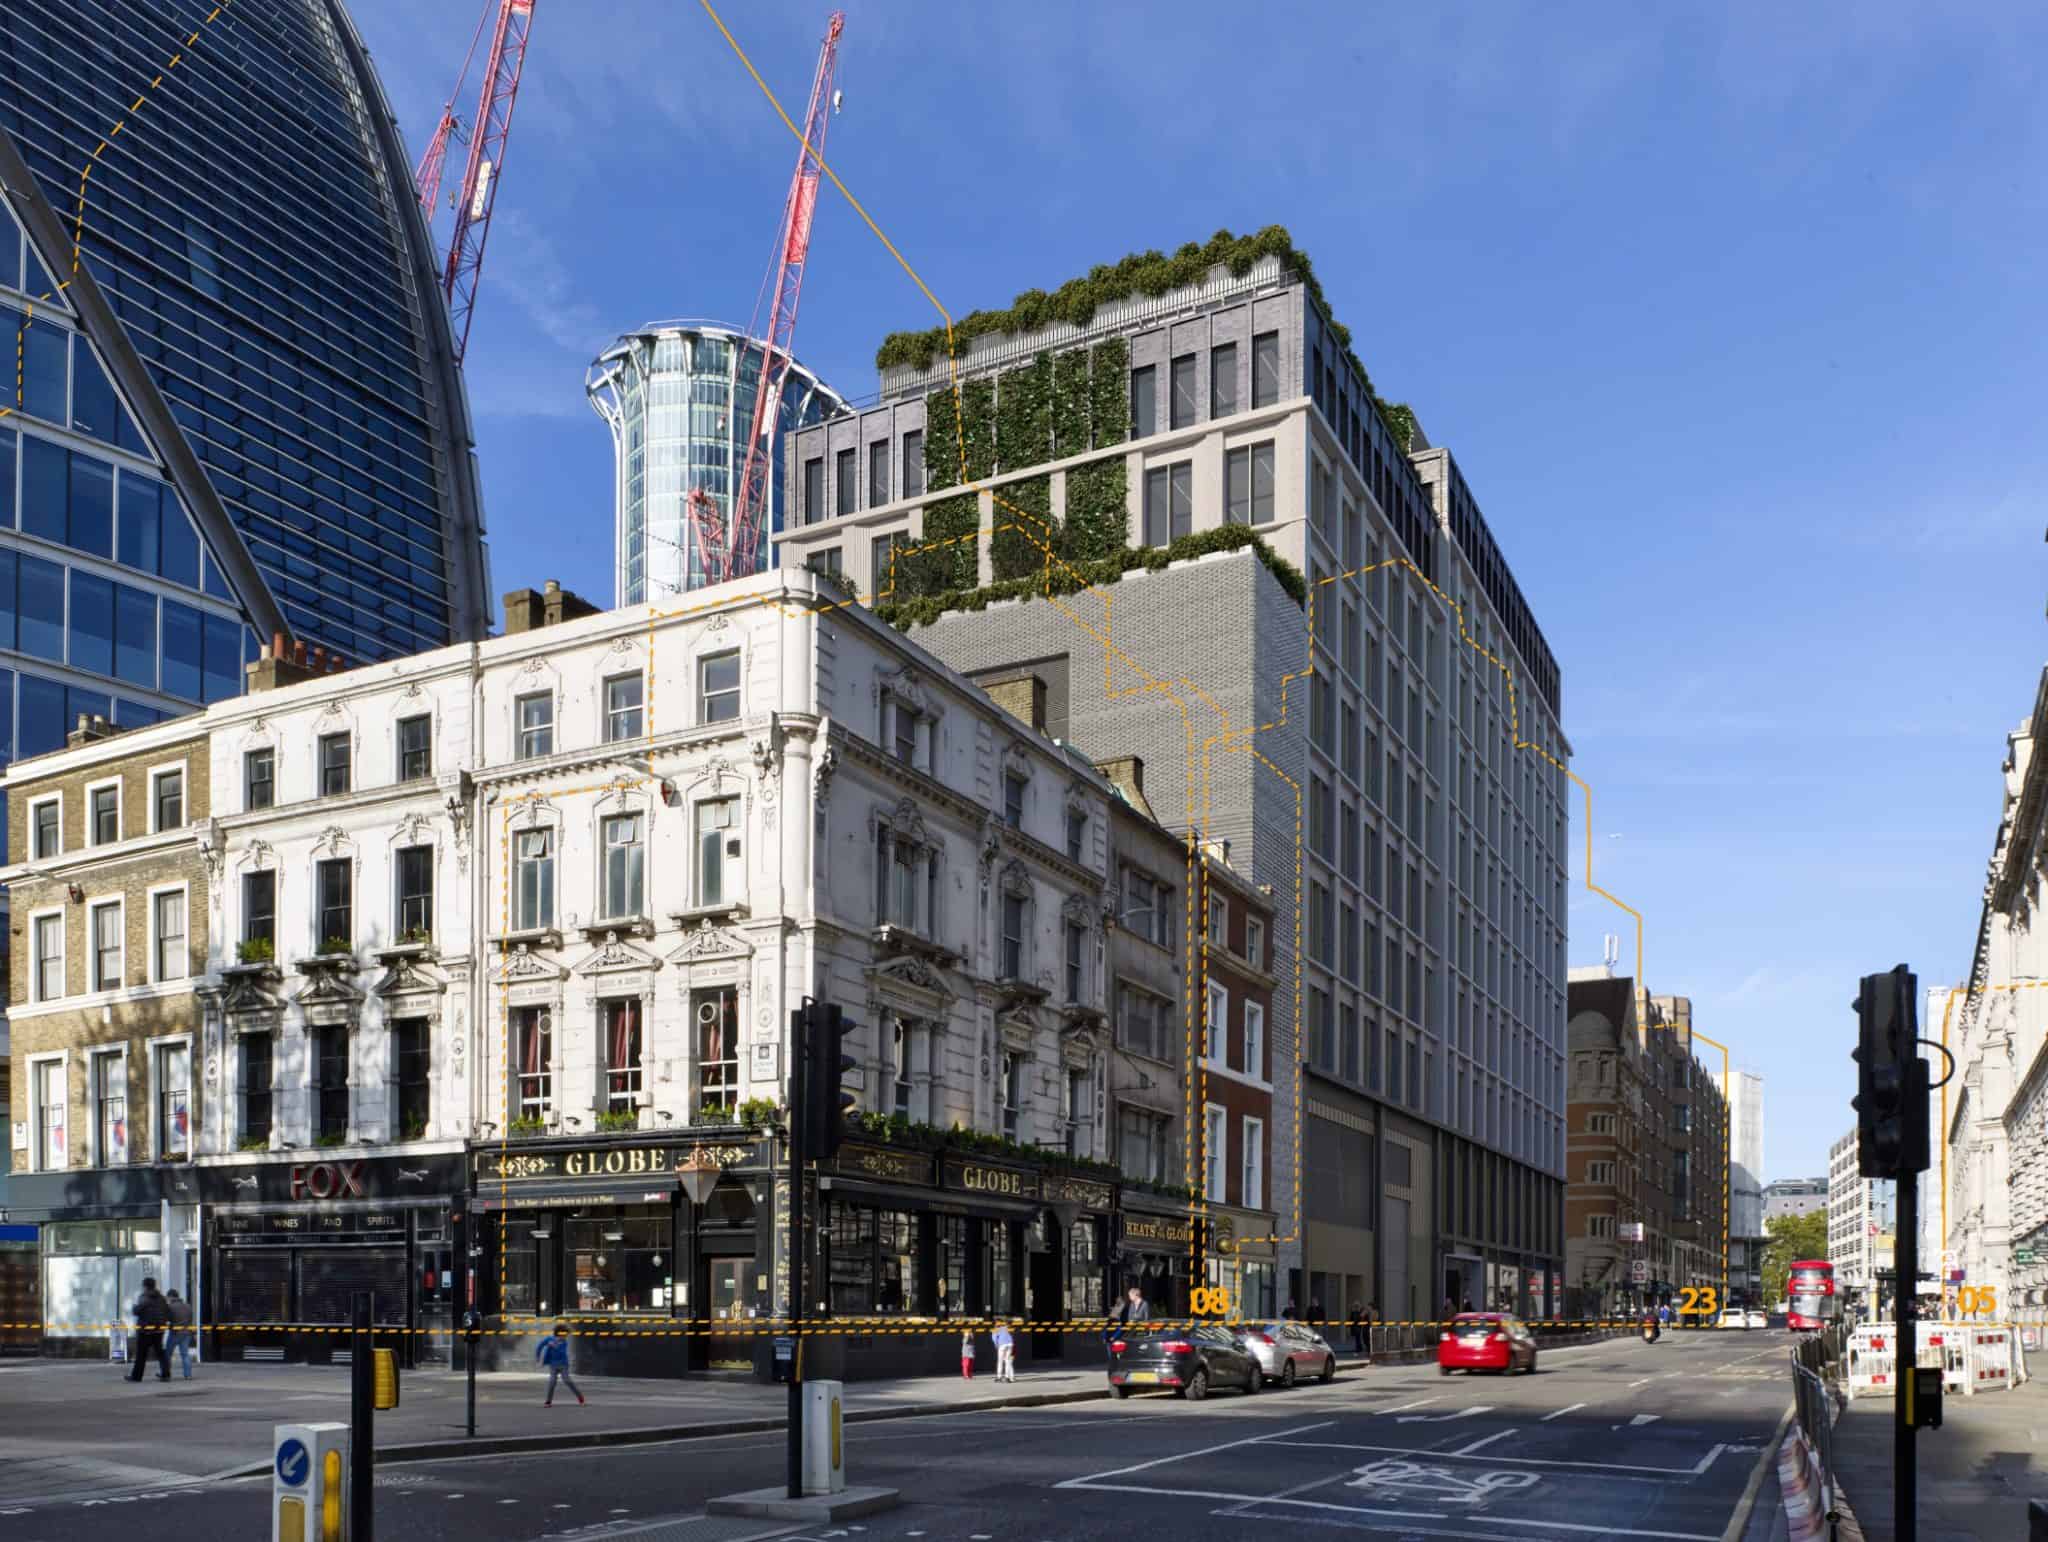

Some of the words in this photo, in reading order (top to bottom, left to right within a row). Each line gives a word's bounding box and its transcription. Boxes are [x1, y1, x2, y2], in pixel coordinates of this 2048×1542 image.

[565, 1148, 667, 1176] GLOBE
[290, 1162, 364, 1200] FOX
[963, 1167, 1022, 1194] GLOBE
